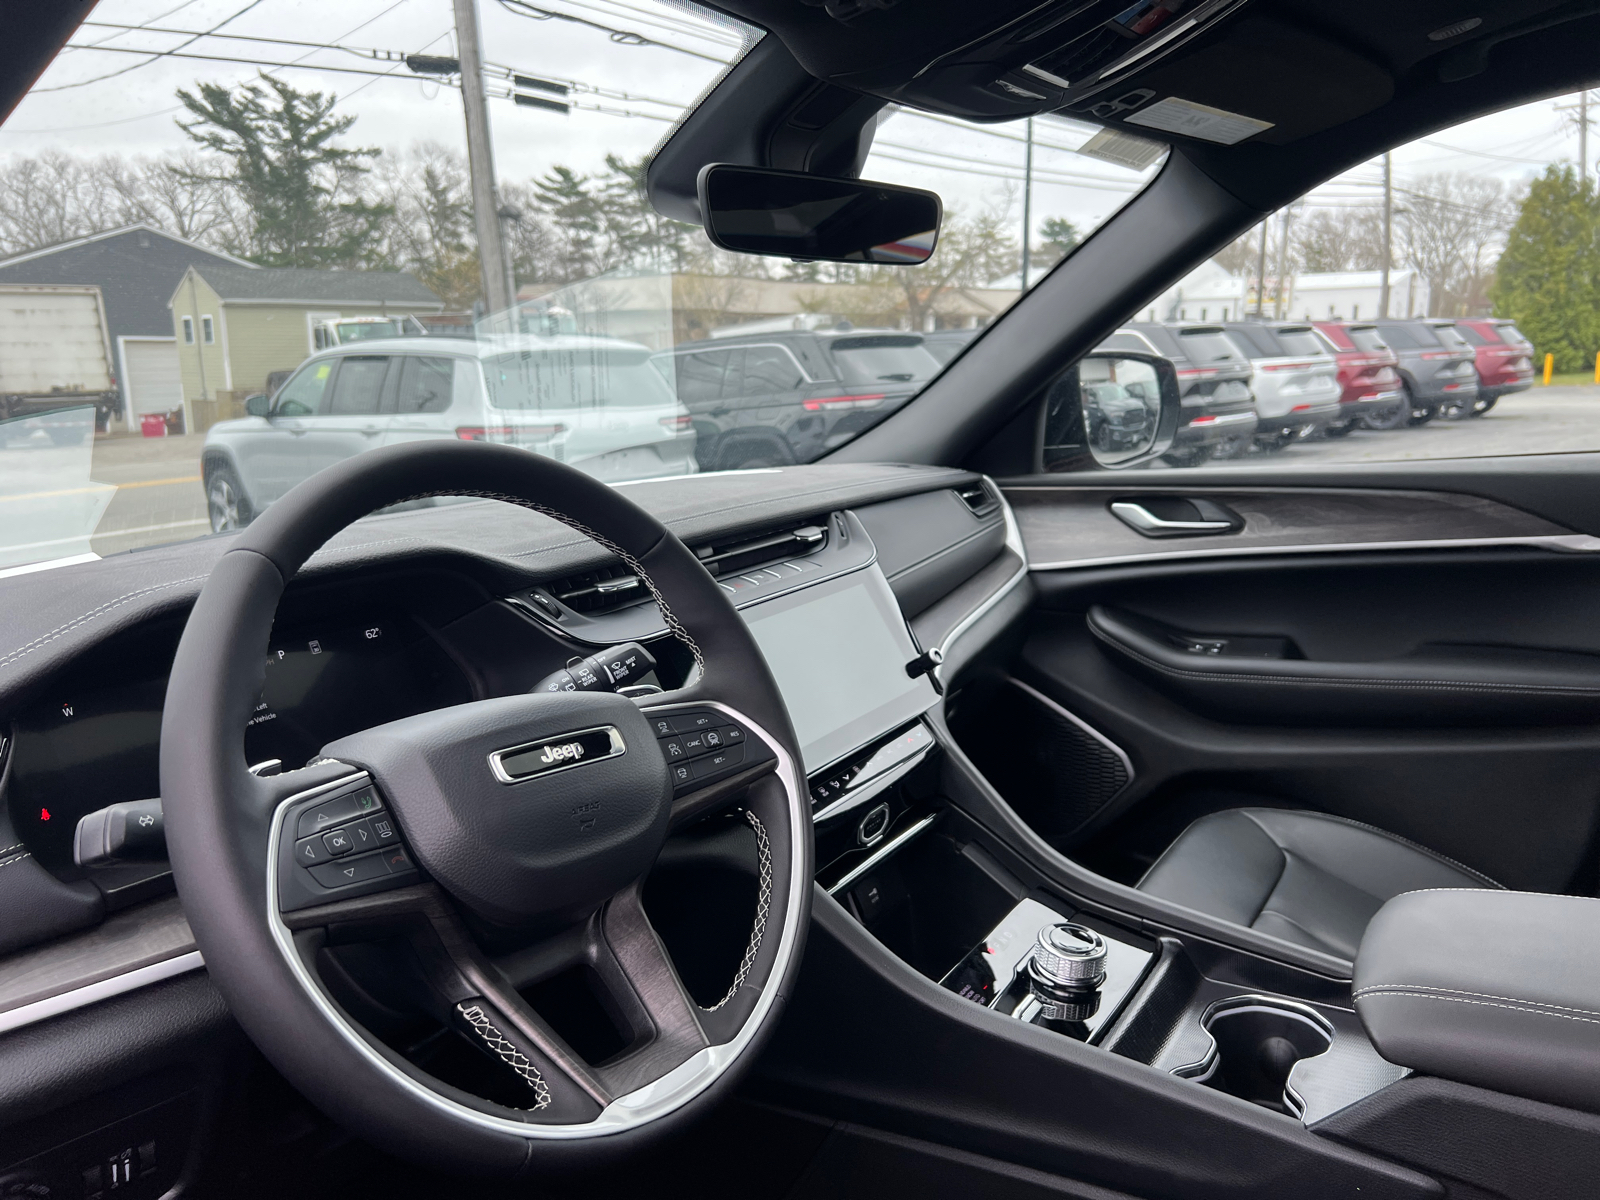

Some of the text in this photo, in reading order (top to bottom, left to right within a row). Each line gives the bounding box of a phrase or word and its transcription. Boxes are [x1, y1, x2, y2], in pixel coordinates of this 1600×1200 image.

[278, 650, 285, 660] P
[613, 665, 627, 676] FRONT
[615, 670, 630, 680] WIPER
[581, 673, 593, 682] REAR
[582, 677, 598, 687] WIPER
[62, 706, 74, 717] W
[253, 712, 277, 724] Vehicle
[540, 742, 585, 763] Jeep
[332, 836, 347, 847] OK
